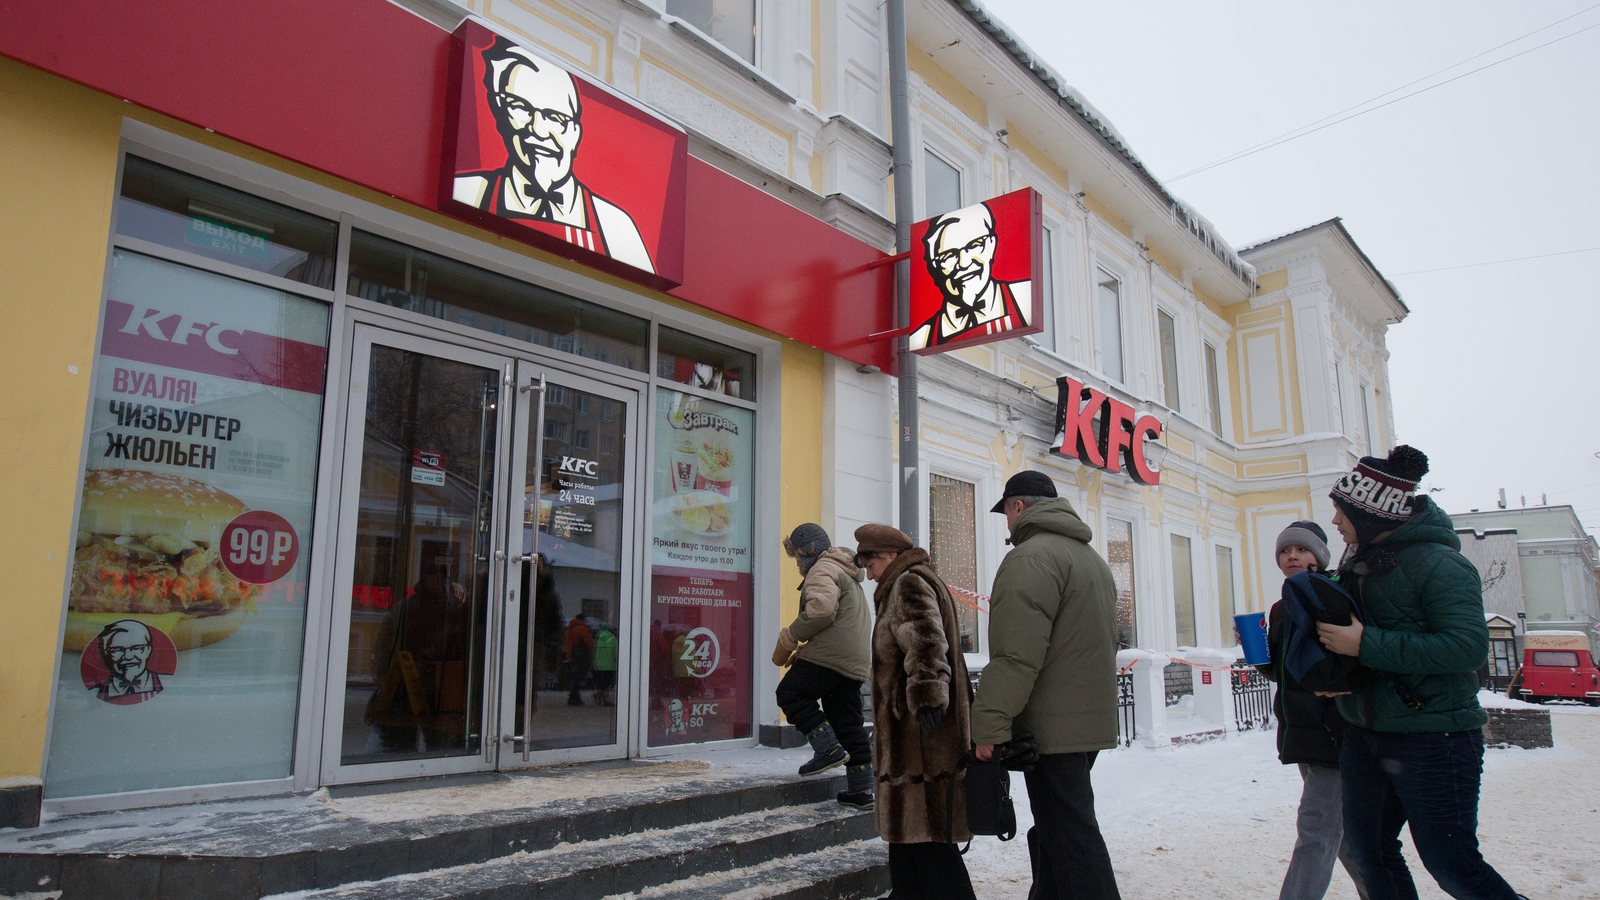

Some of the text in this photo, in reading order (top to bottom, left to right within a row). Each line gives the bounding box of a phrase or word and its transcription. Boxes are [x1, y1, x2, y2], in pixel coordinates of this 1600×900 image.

[192, 218, 265, 251] ВЫХОД
[211, 237, 247, 254] EXIT
[119, 305, 245, 356] KFC
[112, 367, 197, 404] ВУАЛЯ!
[109, 399, 241, 441] ЧИЗБУРГЕР
[683, 408, 739, 435] Завтрак
[1050, 374, 1164, 486] KFC
[104, 432, 217, 470] ЖЮЛЬЕН
[559, 455, 599, 475] KFC
[704, 482, 721, 493] KFC
[1335, 470, 1416, 516] SBURG
[560, 489, 595, 506] 24 часа
[653, 537, 747, 556] Яркий вкус твоего утра!
[667, 552, 693, 561] Каждое
[690, 576, 714, 586] ТЕПЕРЬ
[678, 586, 724, 597] МЫ РАБОТАЕМ
[657, 595, 742, 608] КРУГЛОСУТОЧНО ДЛЯ ВАС!
[679, 639, 711, 661] 24
[692, 659, 712, 668] часа
[691, 703, 719, 716] KFC
[689, 717, 704, 727] SO
